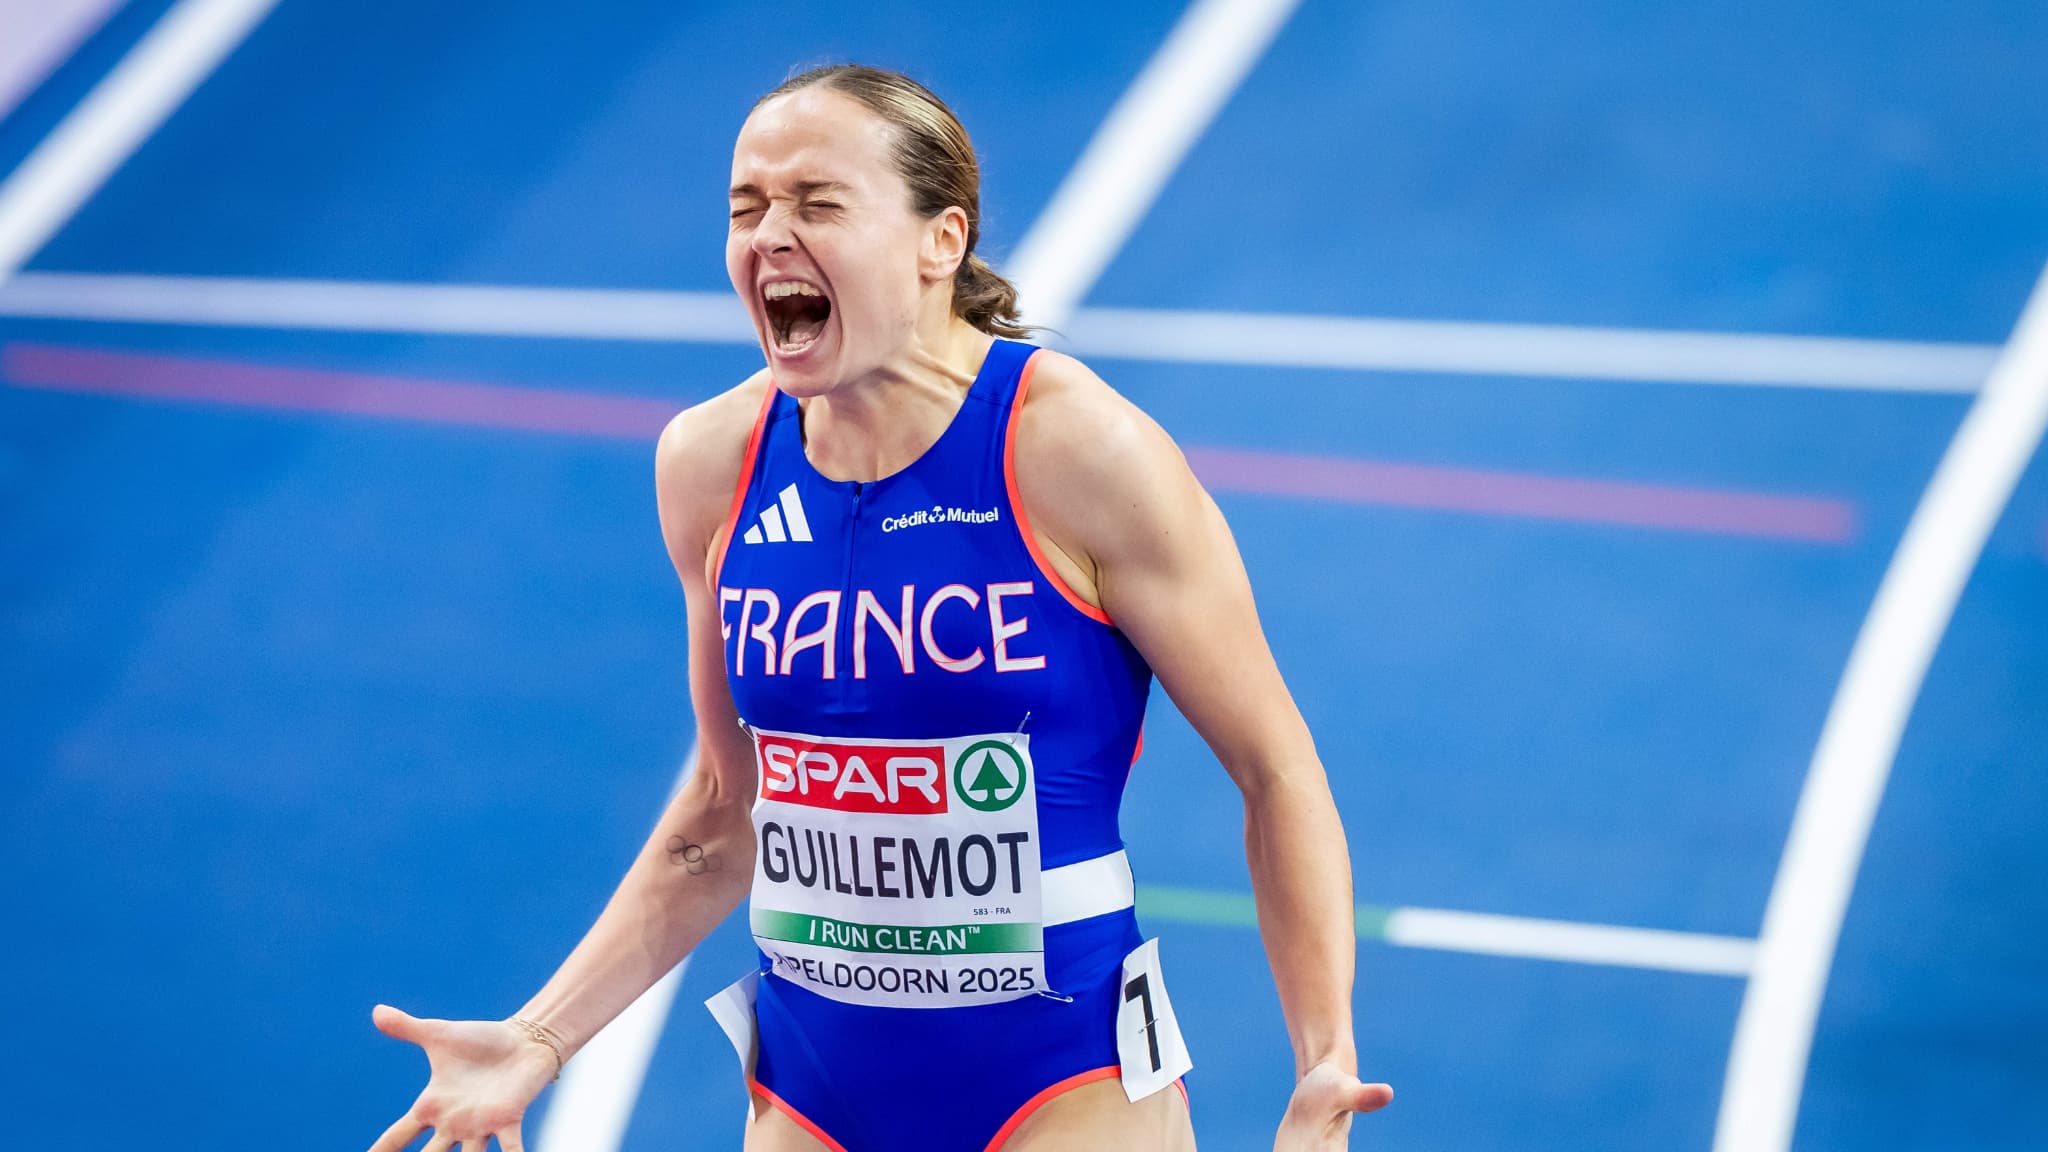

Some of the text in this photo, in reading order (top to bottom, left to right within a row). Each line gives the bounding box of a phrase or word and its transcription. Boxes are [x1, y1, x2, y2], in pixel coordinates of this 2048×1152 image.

[882, 507, 999, 533] Crédit Mutuel
[720, 581, 1047, 680] FRANCE
[763, 743, 941, 804] SPAR
[761, 821, 1029, 899] GUILLEMOT
[973, 908, 989, 916] 583
[995, 907, 1011, 915] FRA
[809, 919, 816, 941] I
[822, 921, 869, 949] RUN
[957, 967, 1035, 993] 2025
